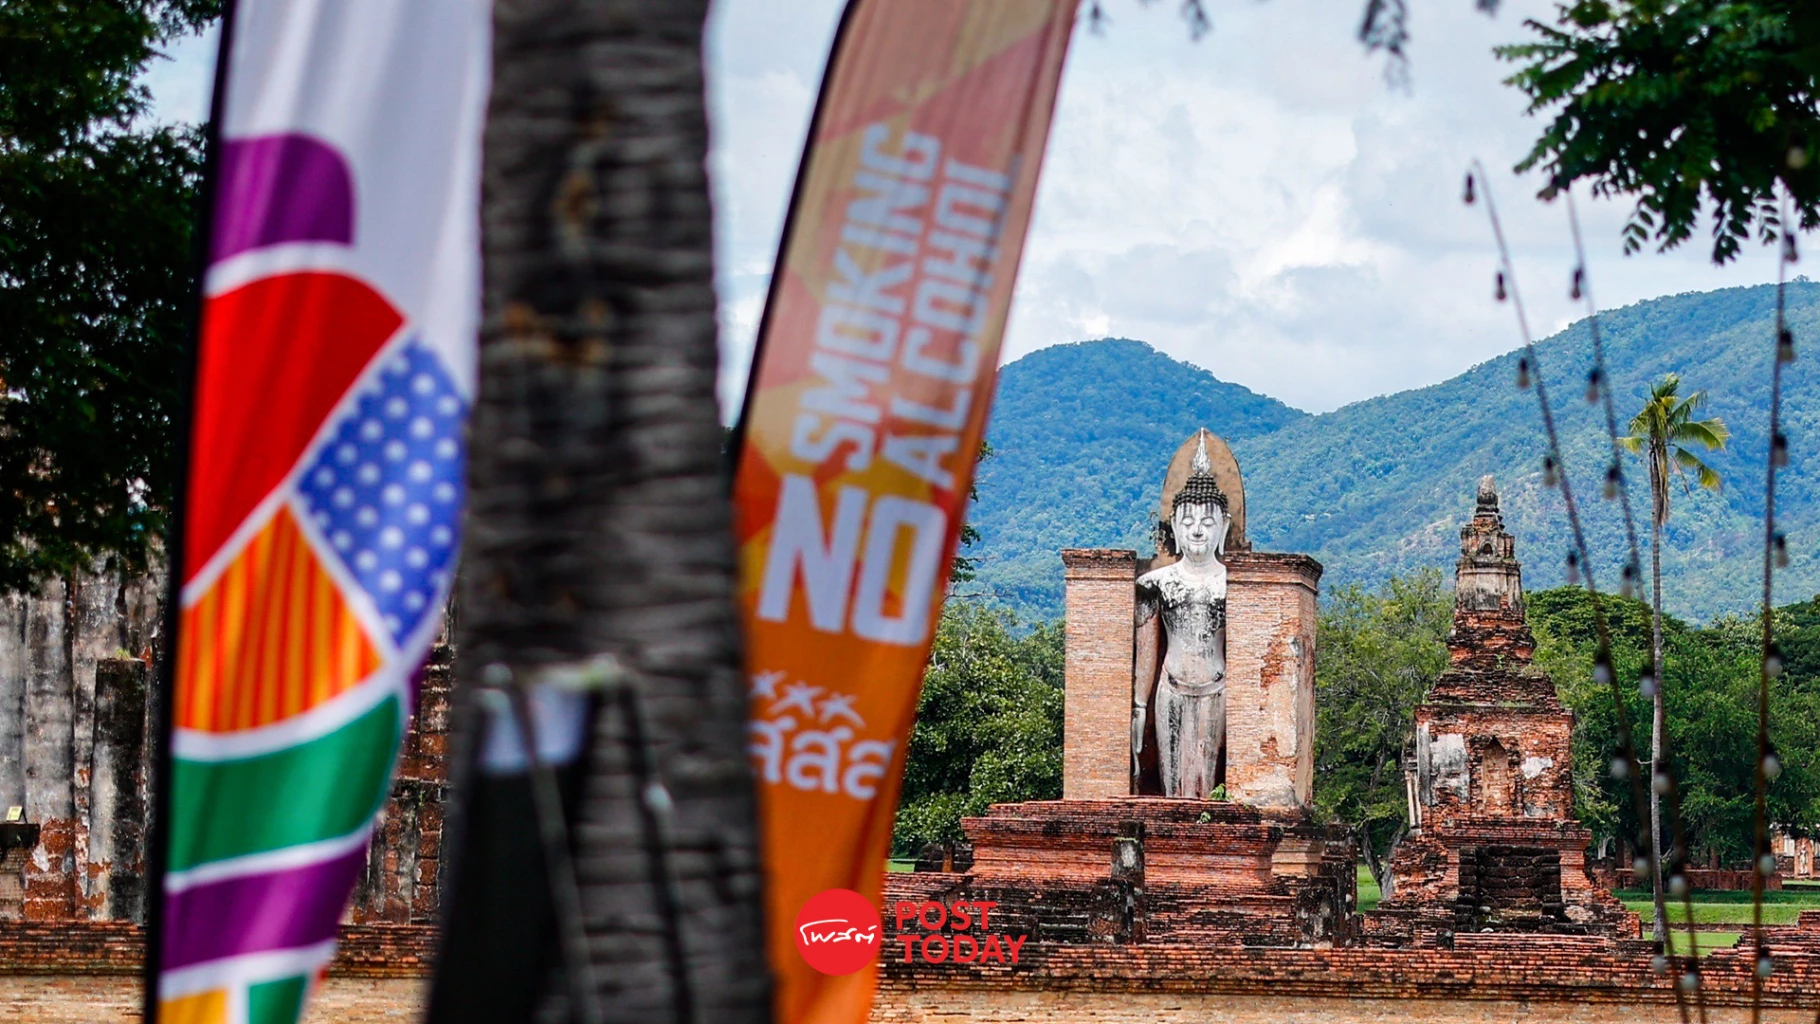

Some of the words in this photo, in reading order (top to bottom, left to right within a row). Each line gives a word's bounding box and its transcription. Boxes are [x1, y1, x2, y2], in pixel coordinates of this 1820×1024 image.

[790, 122, 940, 471] SMOKING
[882, 153, 1022, 491] ALCOHOL
[757, 472, 949, 647] NO
